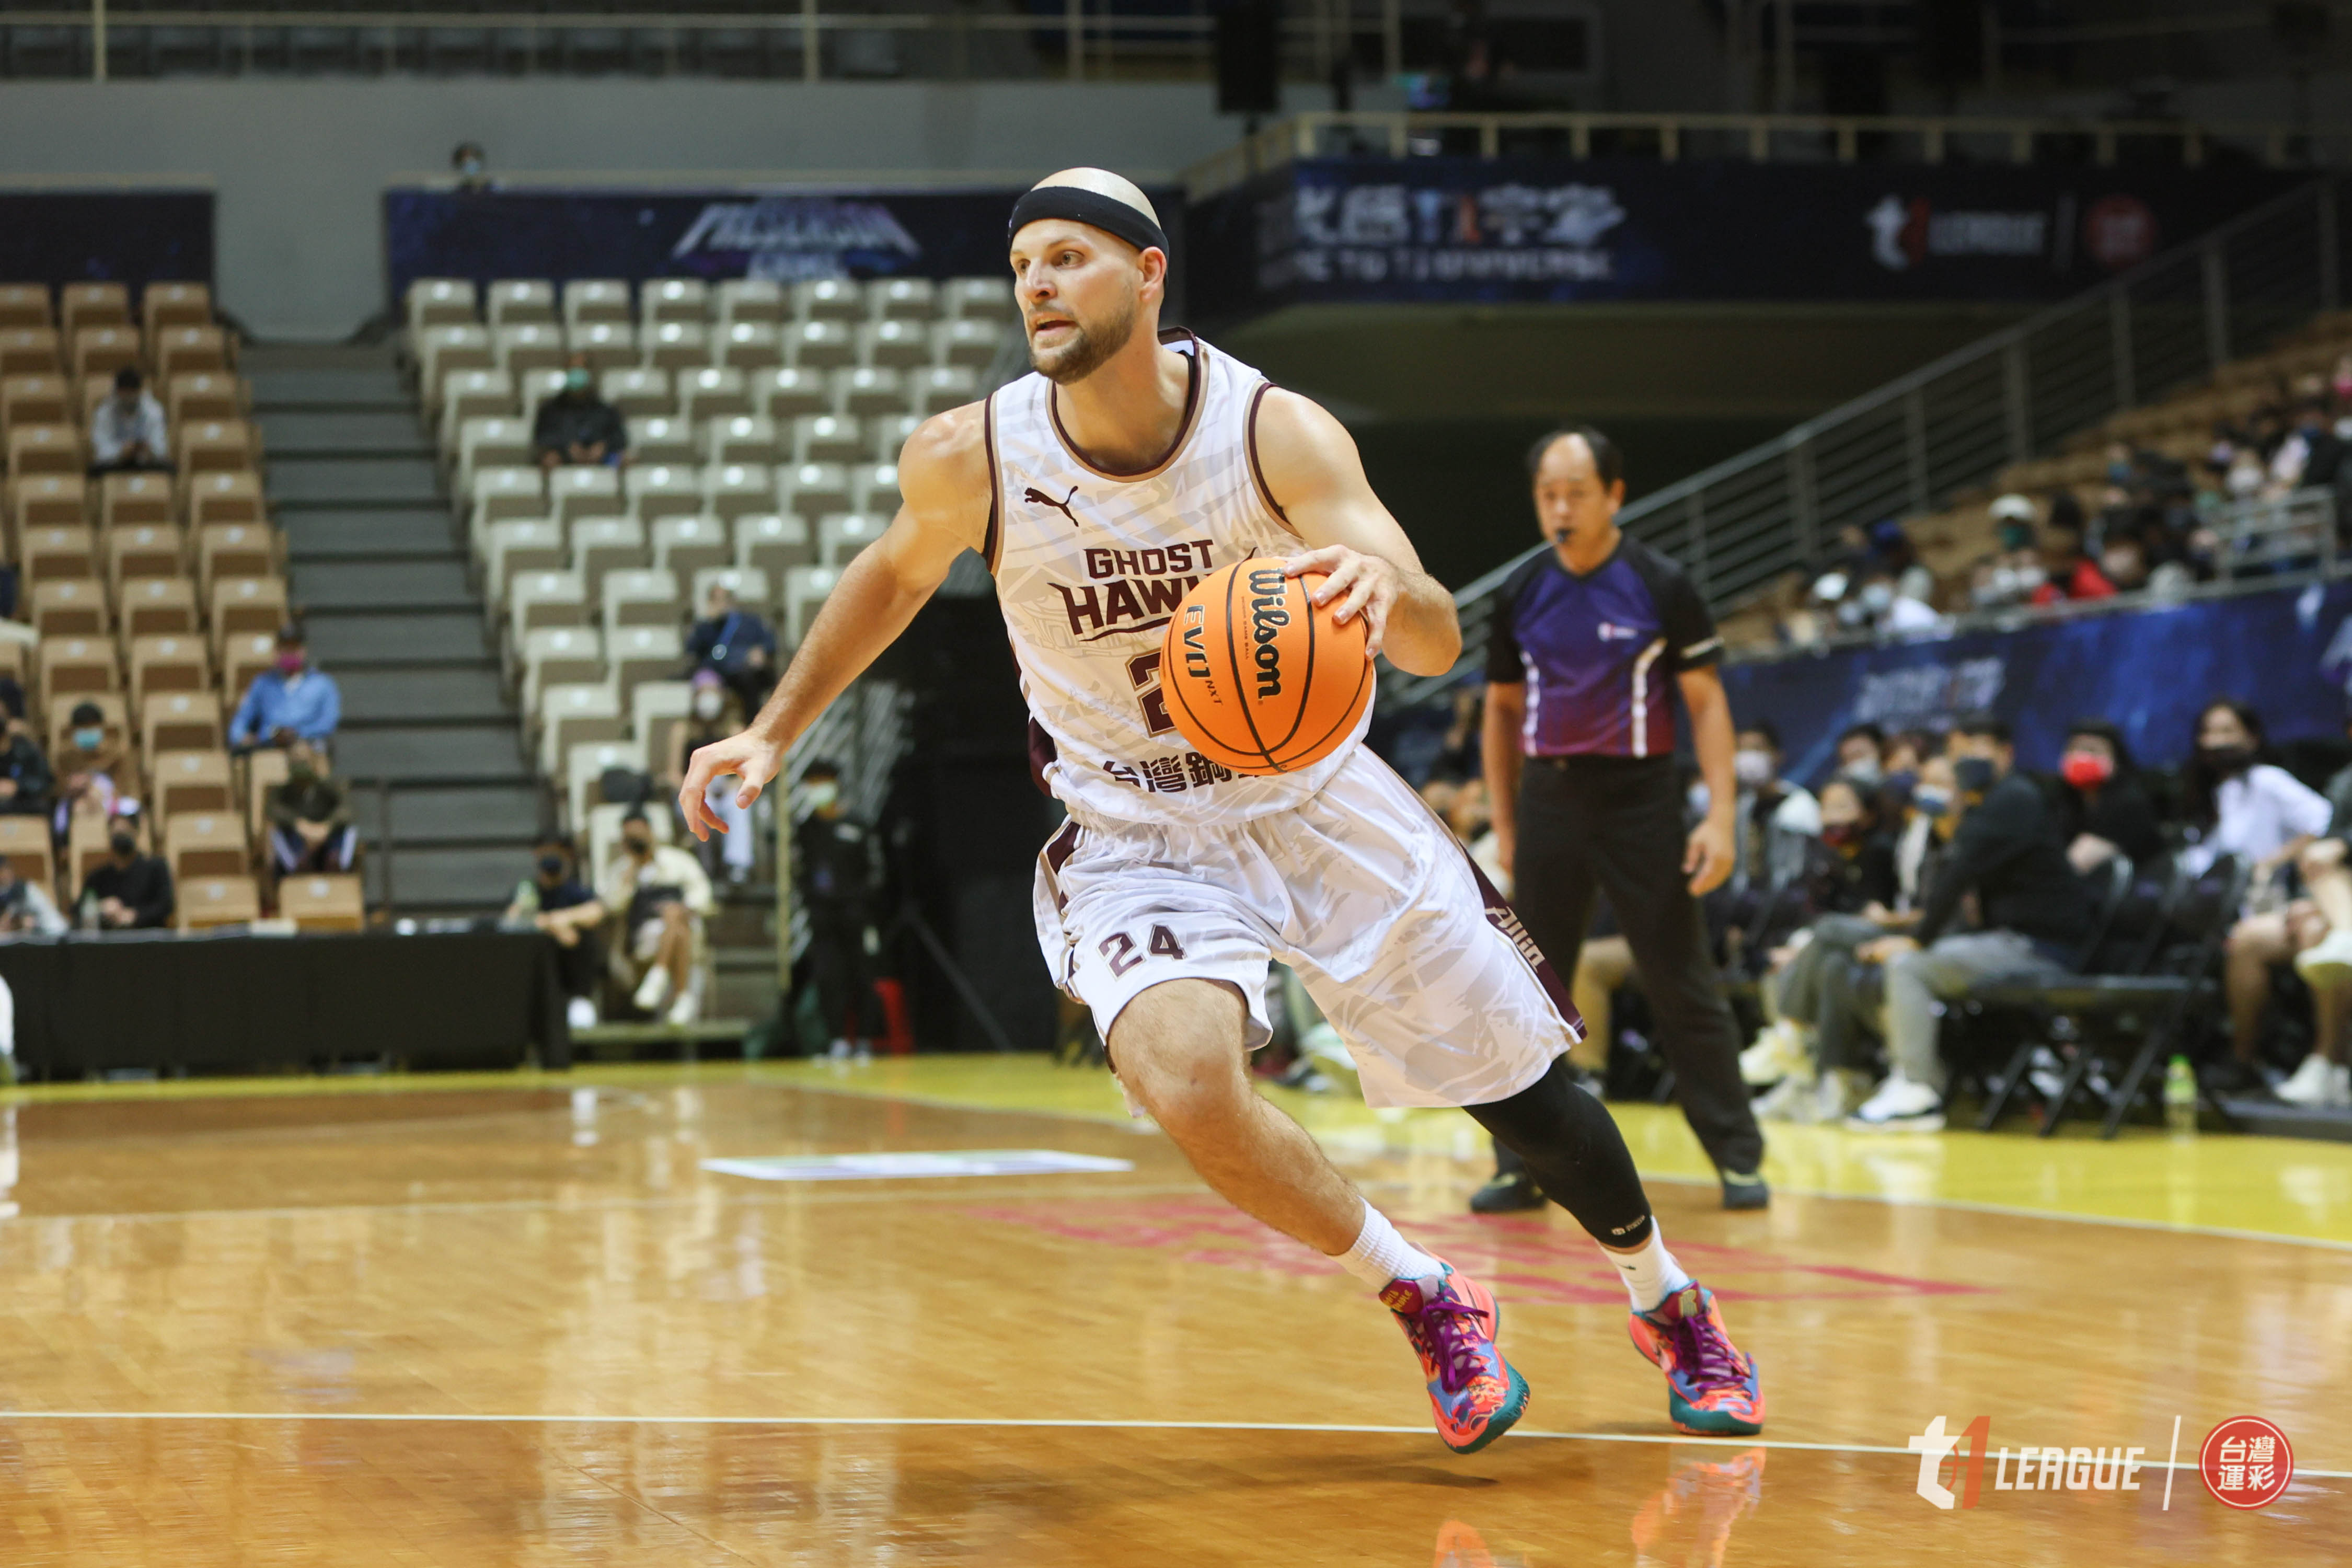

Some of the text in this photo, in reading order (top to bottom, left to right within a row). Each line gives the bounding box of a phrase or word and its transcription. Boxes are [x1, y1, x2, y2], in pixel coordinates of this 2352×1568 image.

[1083, 539, 1213, 579] GHOST
[1047, 574, 1212, 635] HAW
[1249, 567, 1291, 700] Wilson
[1125, 647, 1177, 738] 2
[1205, 679, 1223, 705] NXT
[1103, 752, 1260, 793] 台灣鋼
[1096, 924, 1188, 982] 24
